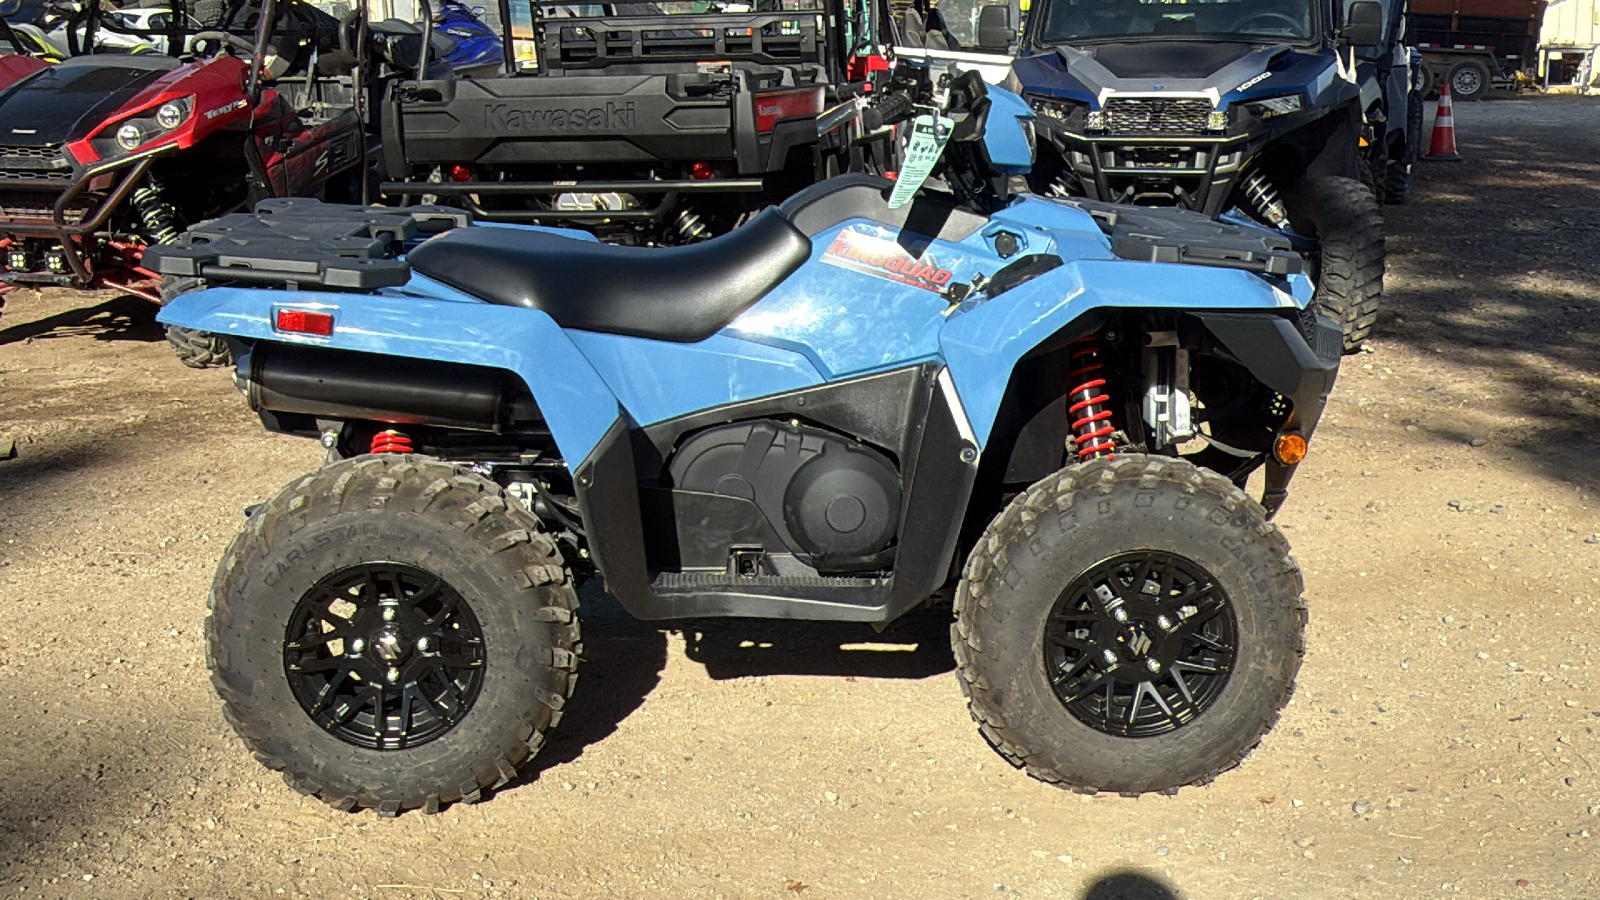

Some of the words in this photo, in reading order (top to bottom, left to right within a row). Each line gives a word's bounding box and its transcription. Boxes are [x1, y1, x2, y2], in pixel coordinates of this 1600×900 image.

[1236, 71, 1272, 92] 1000
[484, 101, 635, 131] Kawasaki
[828, 240, 952, 285] KINGQUAD
[263, 521, 380, 588] CARLSTAR
